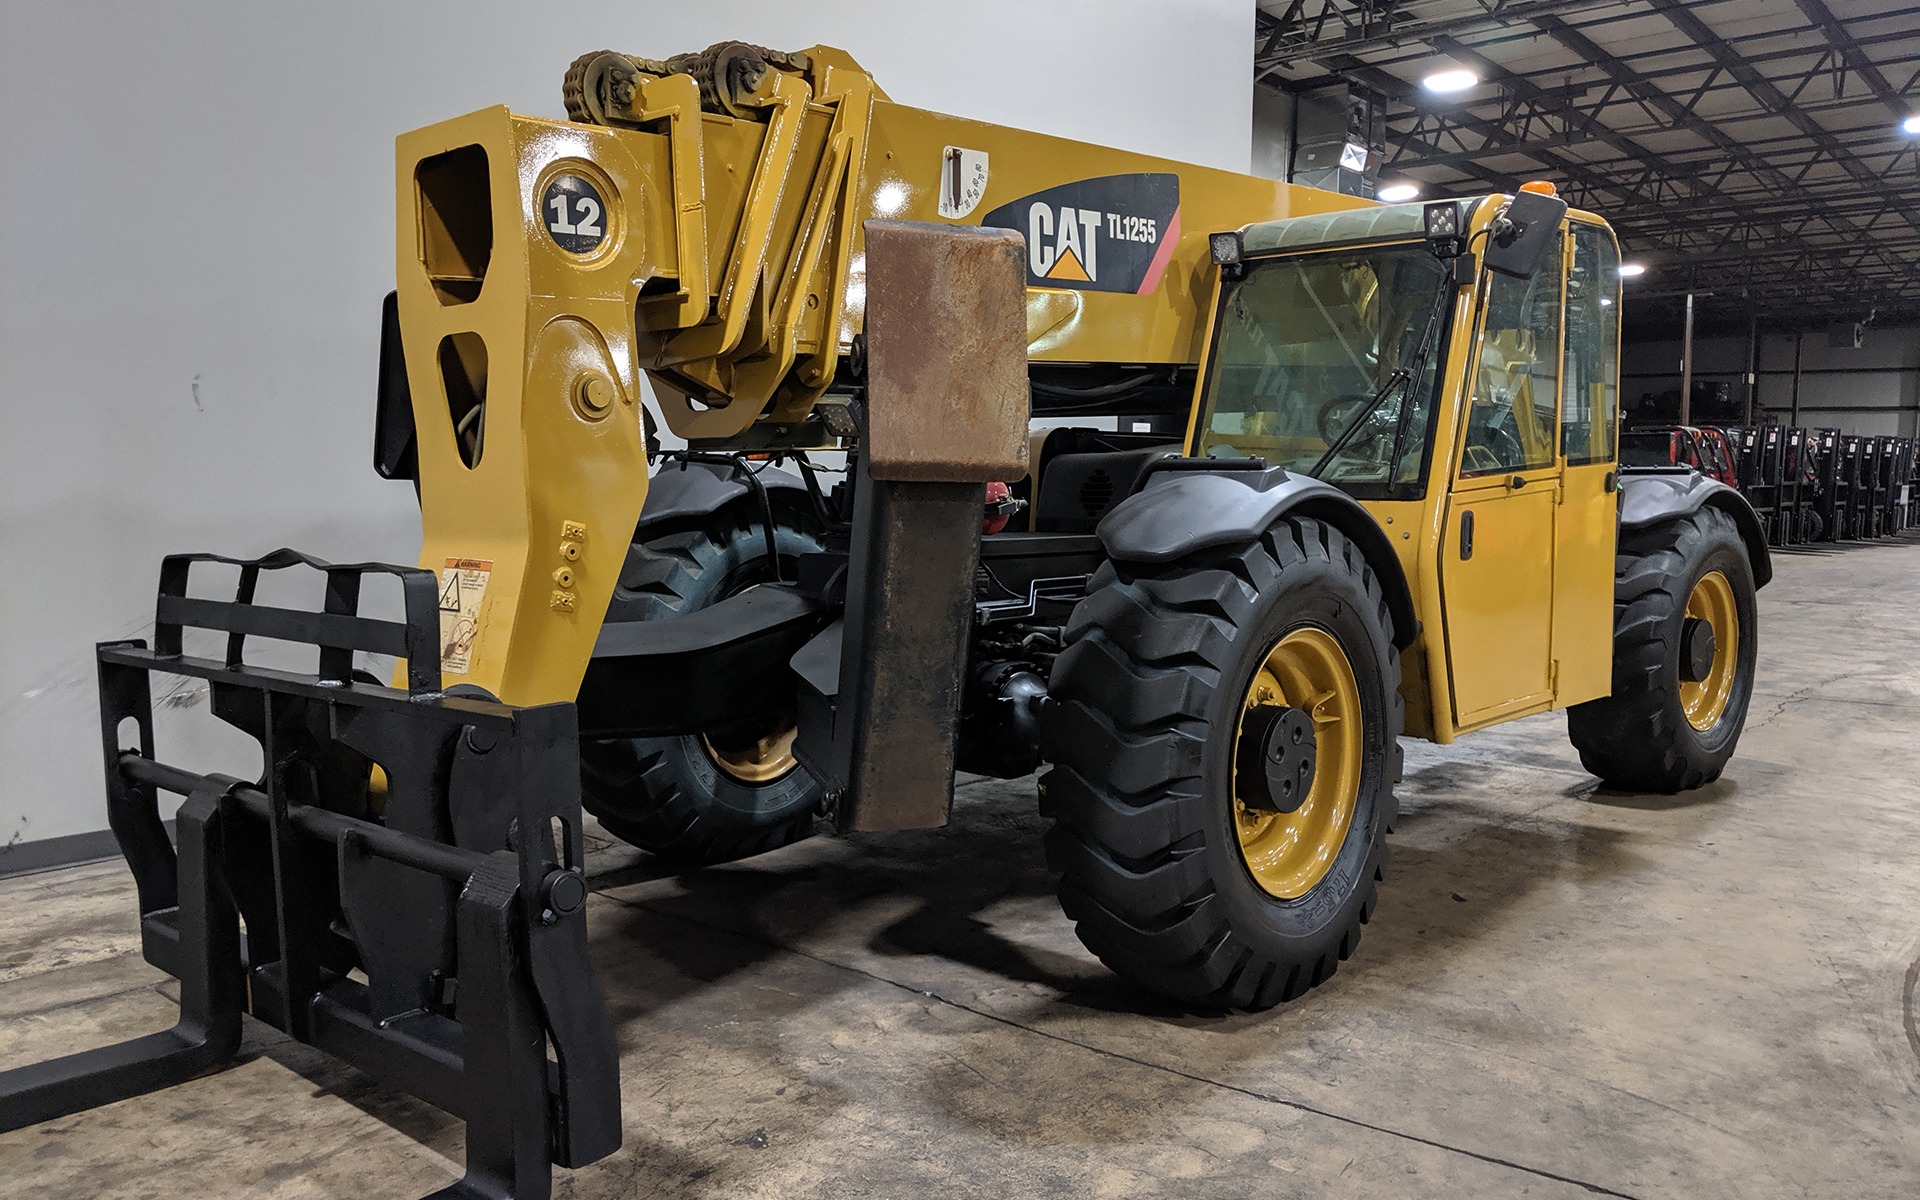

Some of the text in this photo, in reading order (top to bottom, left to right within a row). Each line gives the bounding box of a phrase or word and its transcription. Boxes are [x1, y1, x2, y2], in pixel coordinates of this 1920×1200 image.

[550, 194, 601, 237] 12
[1107, 213, 1157, 244] TL1255
[1029, 201, 1101, 282] CAT
[460, 561, 482, 569] WARNING
